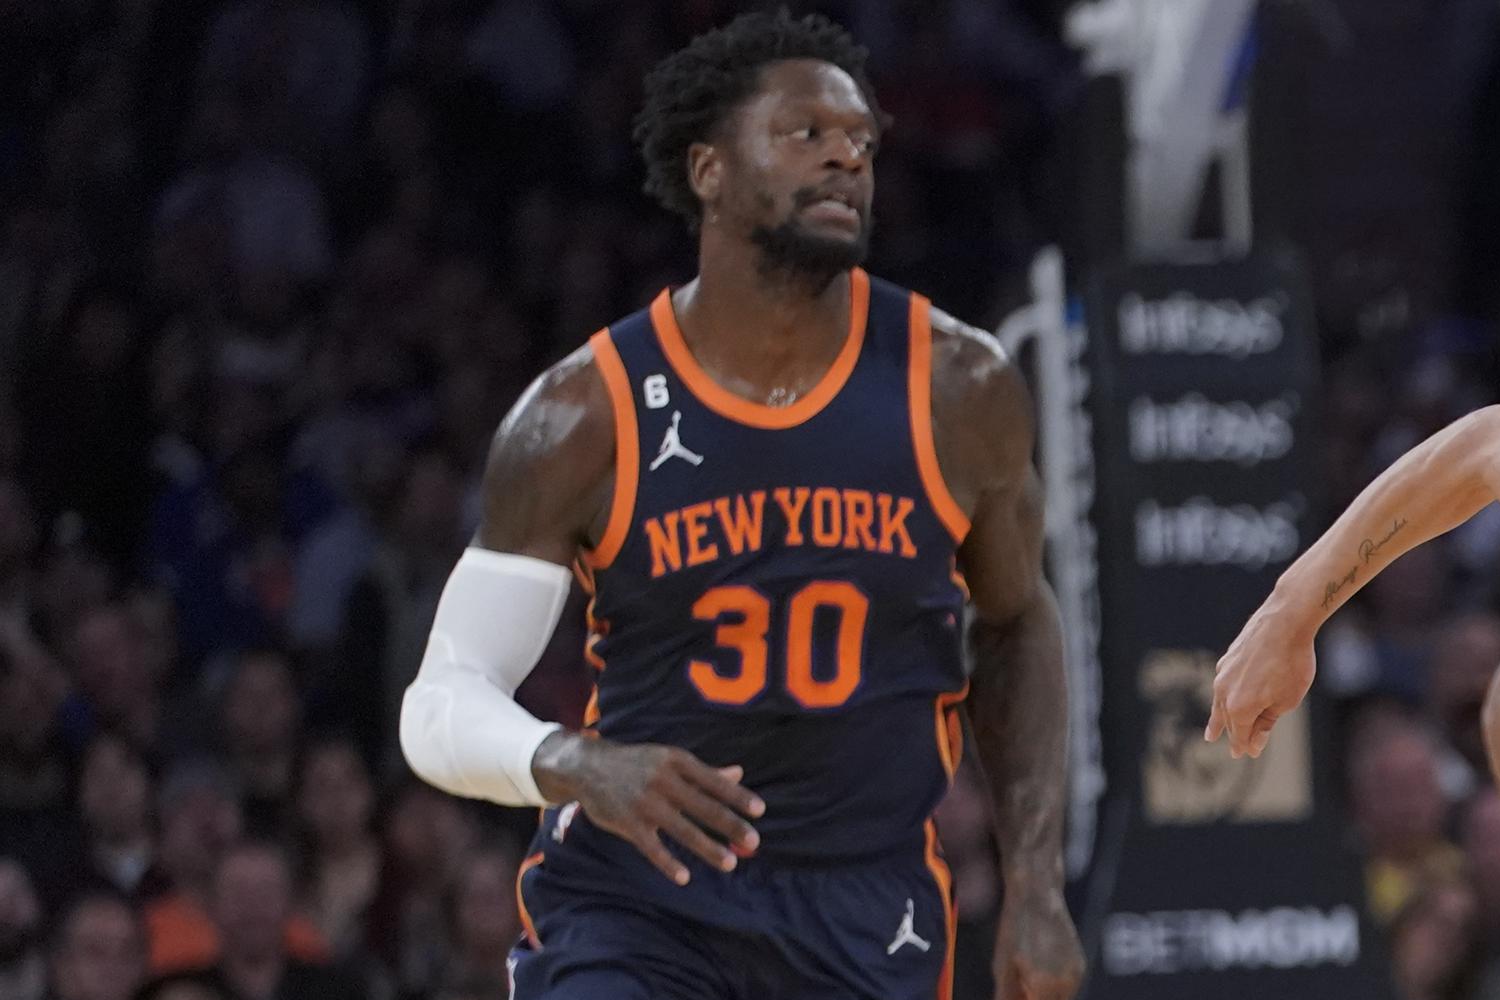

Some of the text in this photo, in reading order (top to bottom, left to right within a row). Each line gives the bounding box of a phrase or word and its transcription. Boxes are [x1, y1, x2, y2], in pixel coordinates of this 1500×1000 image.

[643, 373, 670, 409] 6
[643, 486, 918, 578] NEW YORK
[687, 580, 870, 710] 30
